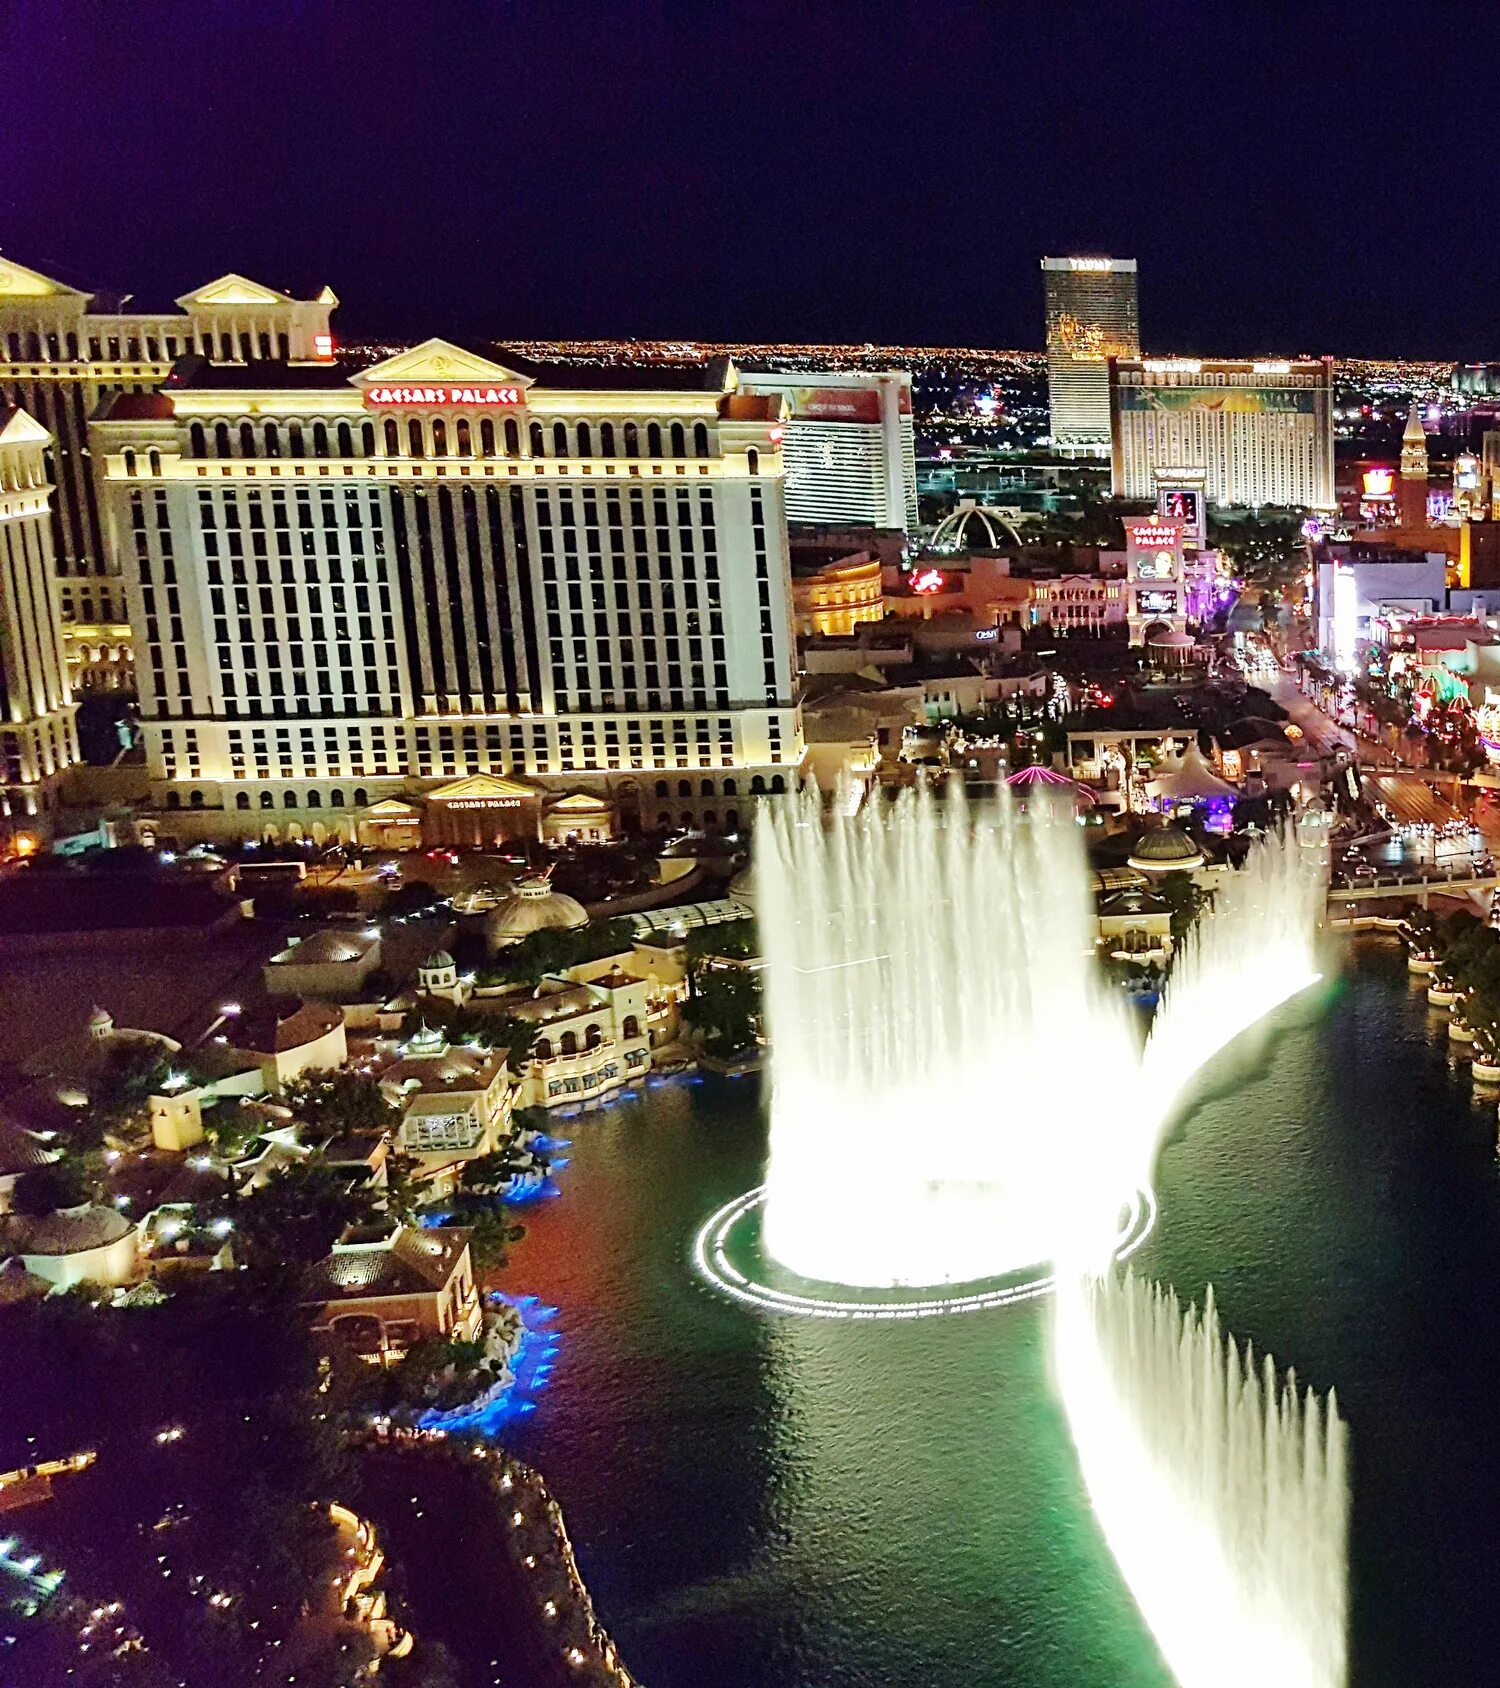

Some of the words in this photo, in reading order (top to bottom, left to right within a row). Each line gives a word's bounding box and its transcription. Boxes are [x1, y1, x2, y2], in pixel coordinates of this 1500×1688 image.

[1069, 257, 1113, 271] TRUMP
[368, 388, 447, 404] CAESARS
[451, 387, 519, 404] PALACE
[1132, 527, 1176, 536] CAESARS
[1135, 536, 1175, 546] PALACE
[447, 801, 485, 809] CAESARS
[487, 800, 521, 808] PALACE
